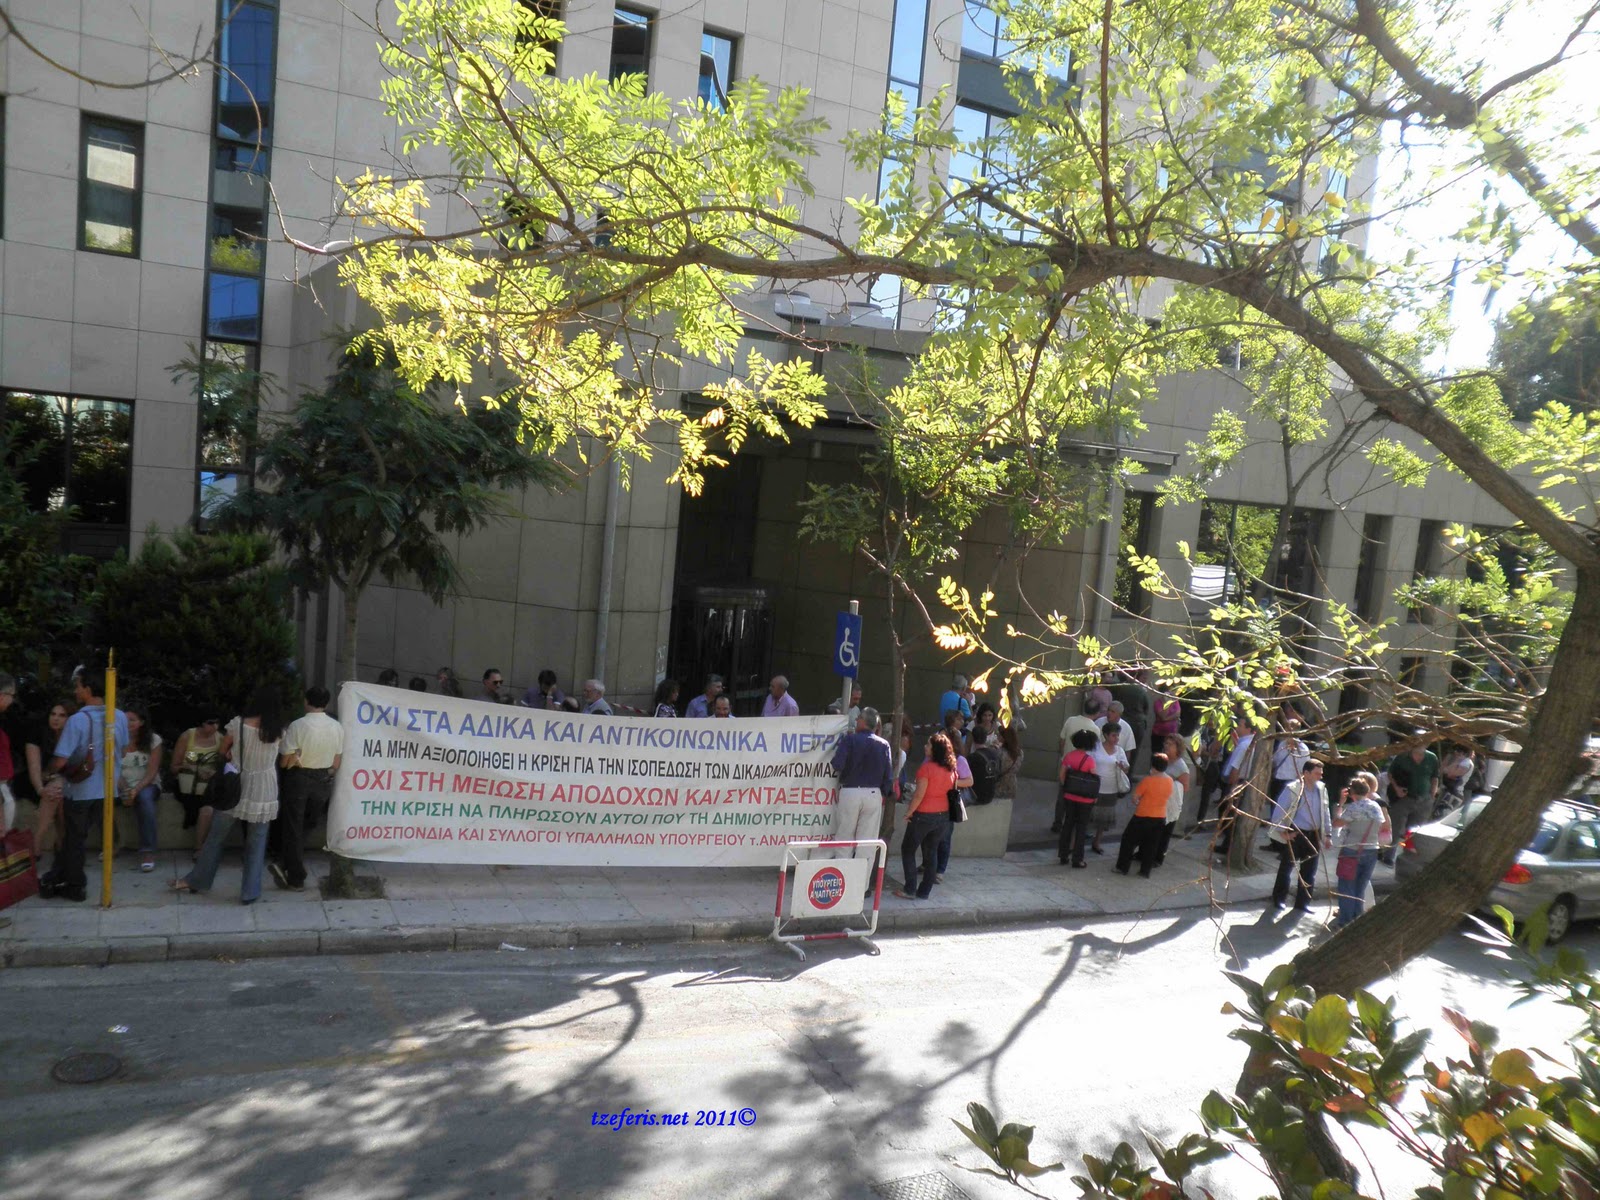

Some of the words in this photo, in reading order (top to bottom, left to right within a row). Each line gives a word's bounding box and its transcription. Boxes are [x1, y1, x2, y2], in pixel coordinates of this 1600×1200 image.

[357, 701, 399, 727] ΟΧΙ
[407, 709, 451, 735] ΣΤΑ
[459, 713, 536, 741] ΑΔΙΚΑ
[544, 720, 584, 743] ΚΑΙ
[588, 724, 768, 753] ΑΝΤΙΚΟΙΝΩΝΙΚΑ
[362, 739, 383, 757] ΝΑ
[387, 740, 418, 759] ΜΗΝ
[421, 746, 514, 769] ΑΞΙΟΠΟΙΗΘΕΙ
[518, 754, 527, 771] Η
[531, 754, 570, 773] ΚΡΙΣΗ
[574, 756, 594, 774] ΓΙΑ
[598, 758, 624, 775] ΤΗΝ
[628, 759, 701, 778] ΙΣΟΠΕΔΩΣΗ
[705, 763, 730, 780] ΤΩΝ
[733, 762, 813, 780] ΔΙΚΑΙΩΜΑΤΩΝ
[352, 769, 392, 791] ΟΧΙ
[399, 771, 445, 793] ΣΤΗ
[451, 774, 545, 801] ΜΕΙΩΣΗ
[549, 783, 679, 806] ΑΠΟΔΟΧΩΝ
[685, 788, 720, 807] ΚΑΙ
[722, 787, 840, 806] ΣΥΝΤΑΞΕΩΝ
[361, 800, 396, 816] ΤΗΝ
[401, 801, 453, 817] ΚΡΙΣΗ
[459, 803, 483, 818] ΝΑ
[489, 805, 597, 825] ΠΛΗΡΩΣΟΥΝ
[600, 812, 648, 825] ΑΥΤΟΙ
[652, 813, 685, 825] ΠΟΥ
[689, 812, 708, 825] ΤΗ
[712, 812, 831, 827] ΔΗΜΙΟΥΡΓΗΣΑΝ
[346, 825, 453, 840] ΟΜΟΣΠΟΝΔΙΑ
[459, 828, 484, 842] ΚΑΙ
[488, 829, 561, 844] ΣΥΛΛΟΓΟΙ
[566, 832, 655, 845] ΥΠΑΛΛΗΛΩΝ
[660, 833, 746, 846] ΥΠΟΥΡΓΕΙΟΥ
